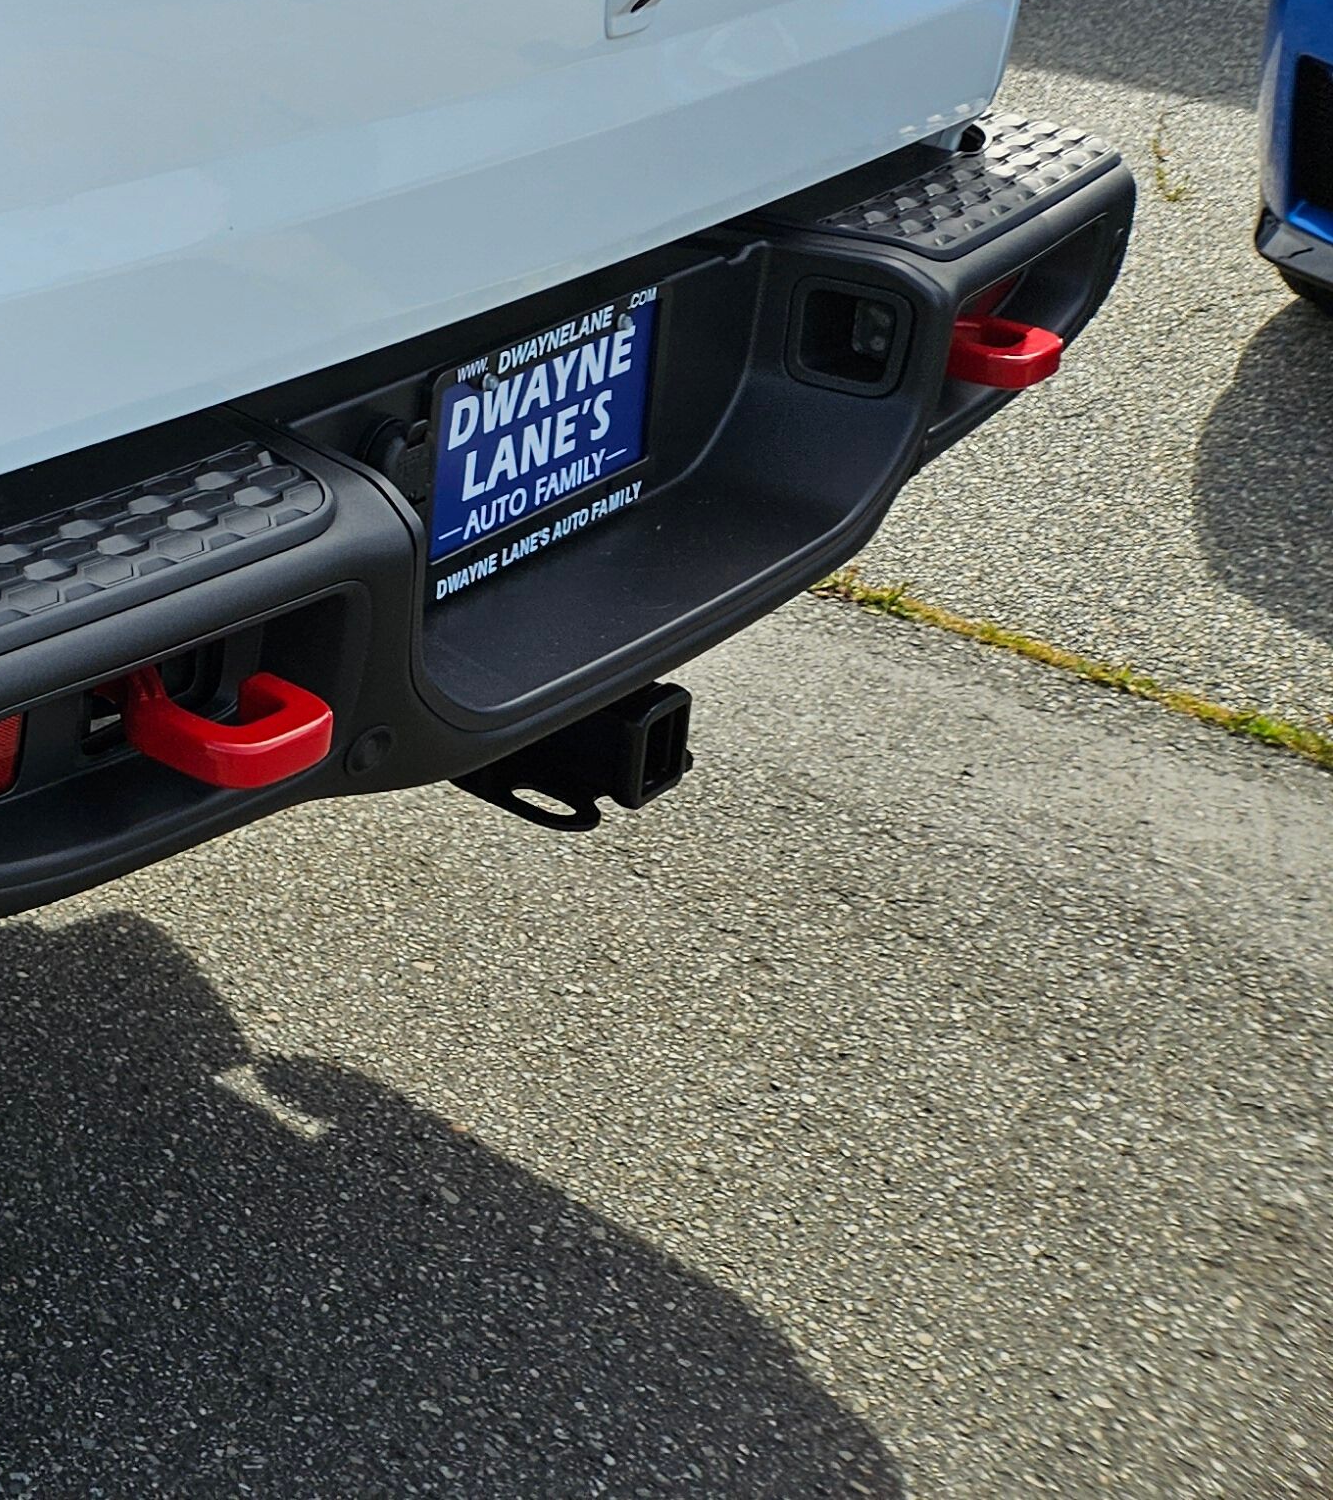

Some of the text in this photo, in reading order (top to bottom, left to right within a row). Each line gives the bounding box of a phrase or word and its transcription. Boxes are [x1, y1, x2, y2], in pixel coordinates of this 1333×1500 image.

[497, 304, 615, 375] DWAYNELANE
[627, 286, 658, 310] .COM
[447, 324, 637, 451] DWAYNE
[462, 389, 613, 502] LANE'S
[463, 447, 607, 540] AUTO FAMILY
[436, 480, 643, 601] DWAYNE LANE'S AUTO FAMILY
